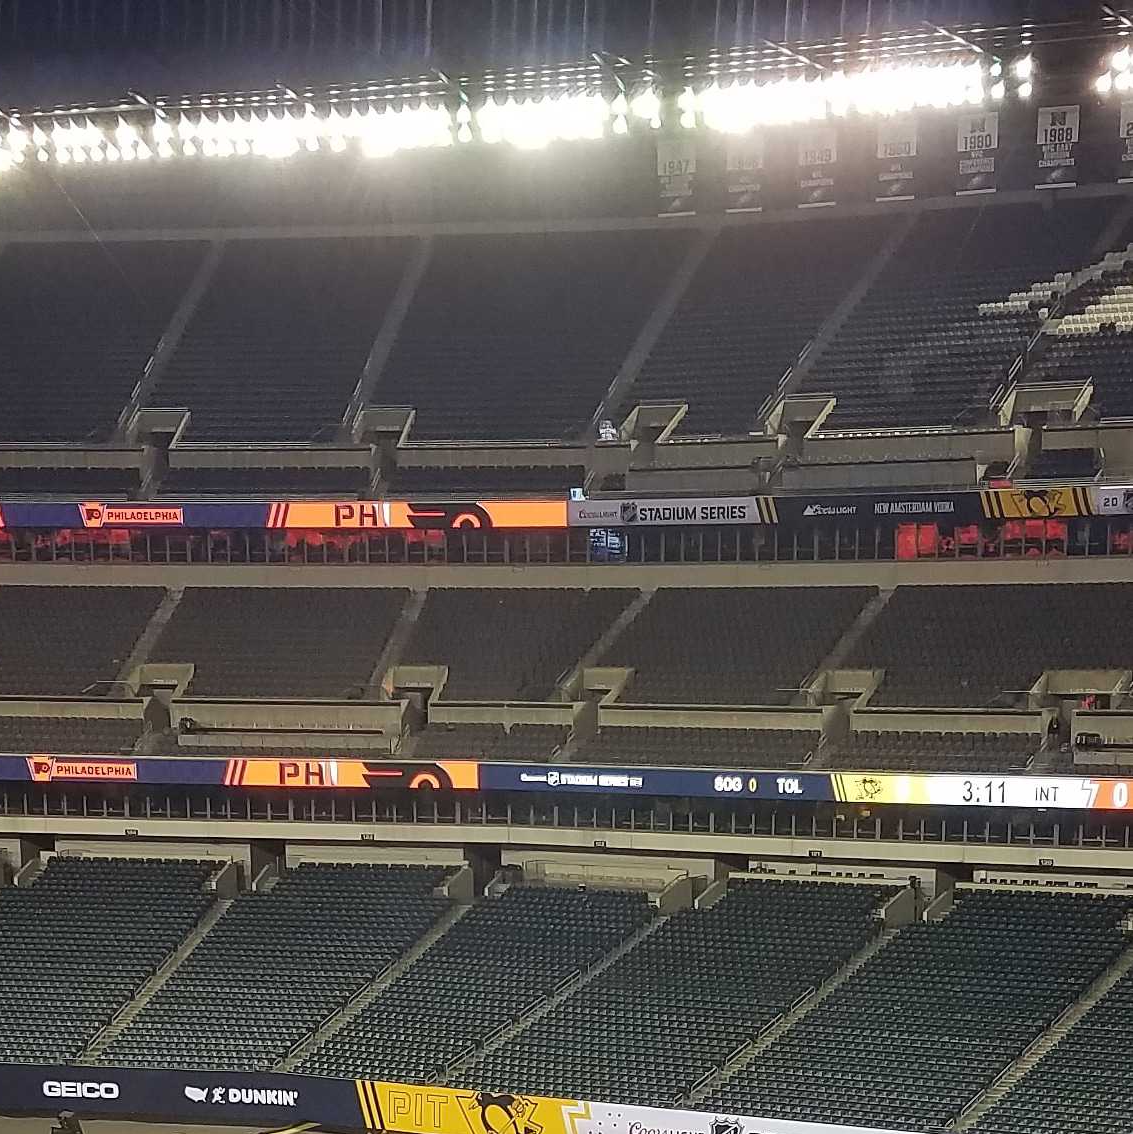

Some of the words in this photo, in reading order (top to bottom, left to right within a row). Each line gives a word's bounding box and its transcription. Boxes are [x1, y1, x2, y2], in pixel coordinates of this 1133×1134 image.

[963, 134, 992, 149] 1980
[1044, 127, 1073, 143] 1988
[108, 510, 180, 522] PHILADELPHIA
[639, 506, 697, 521] STADIUM
[701, 505, 747, 520] SERIES
[891, 502, 933, 514] AMSTERDAM
[56, 765, 133, 777] PHILADELPHIA
[962, 780, 1006, 803] 3:11
[1035, 786, 1059, 802] INT
[43, 1081, 120, 1100] GEICO
[229, 1088, 299, 1107] DUNKIN'
[388, 1090, 449, 1129] PIT
